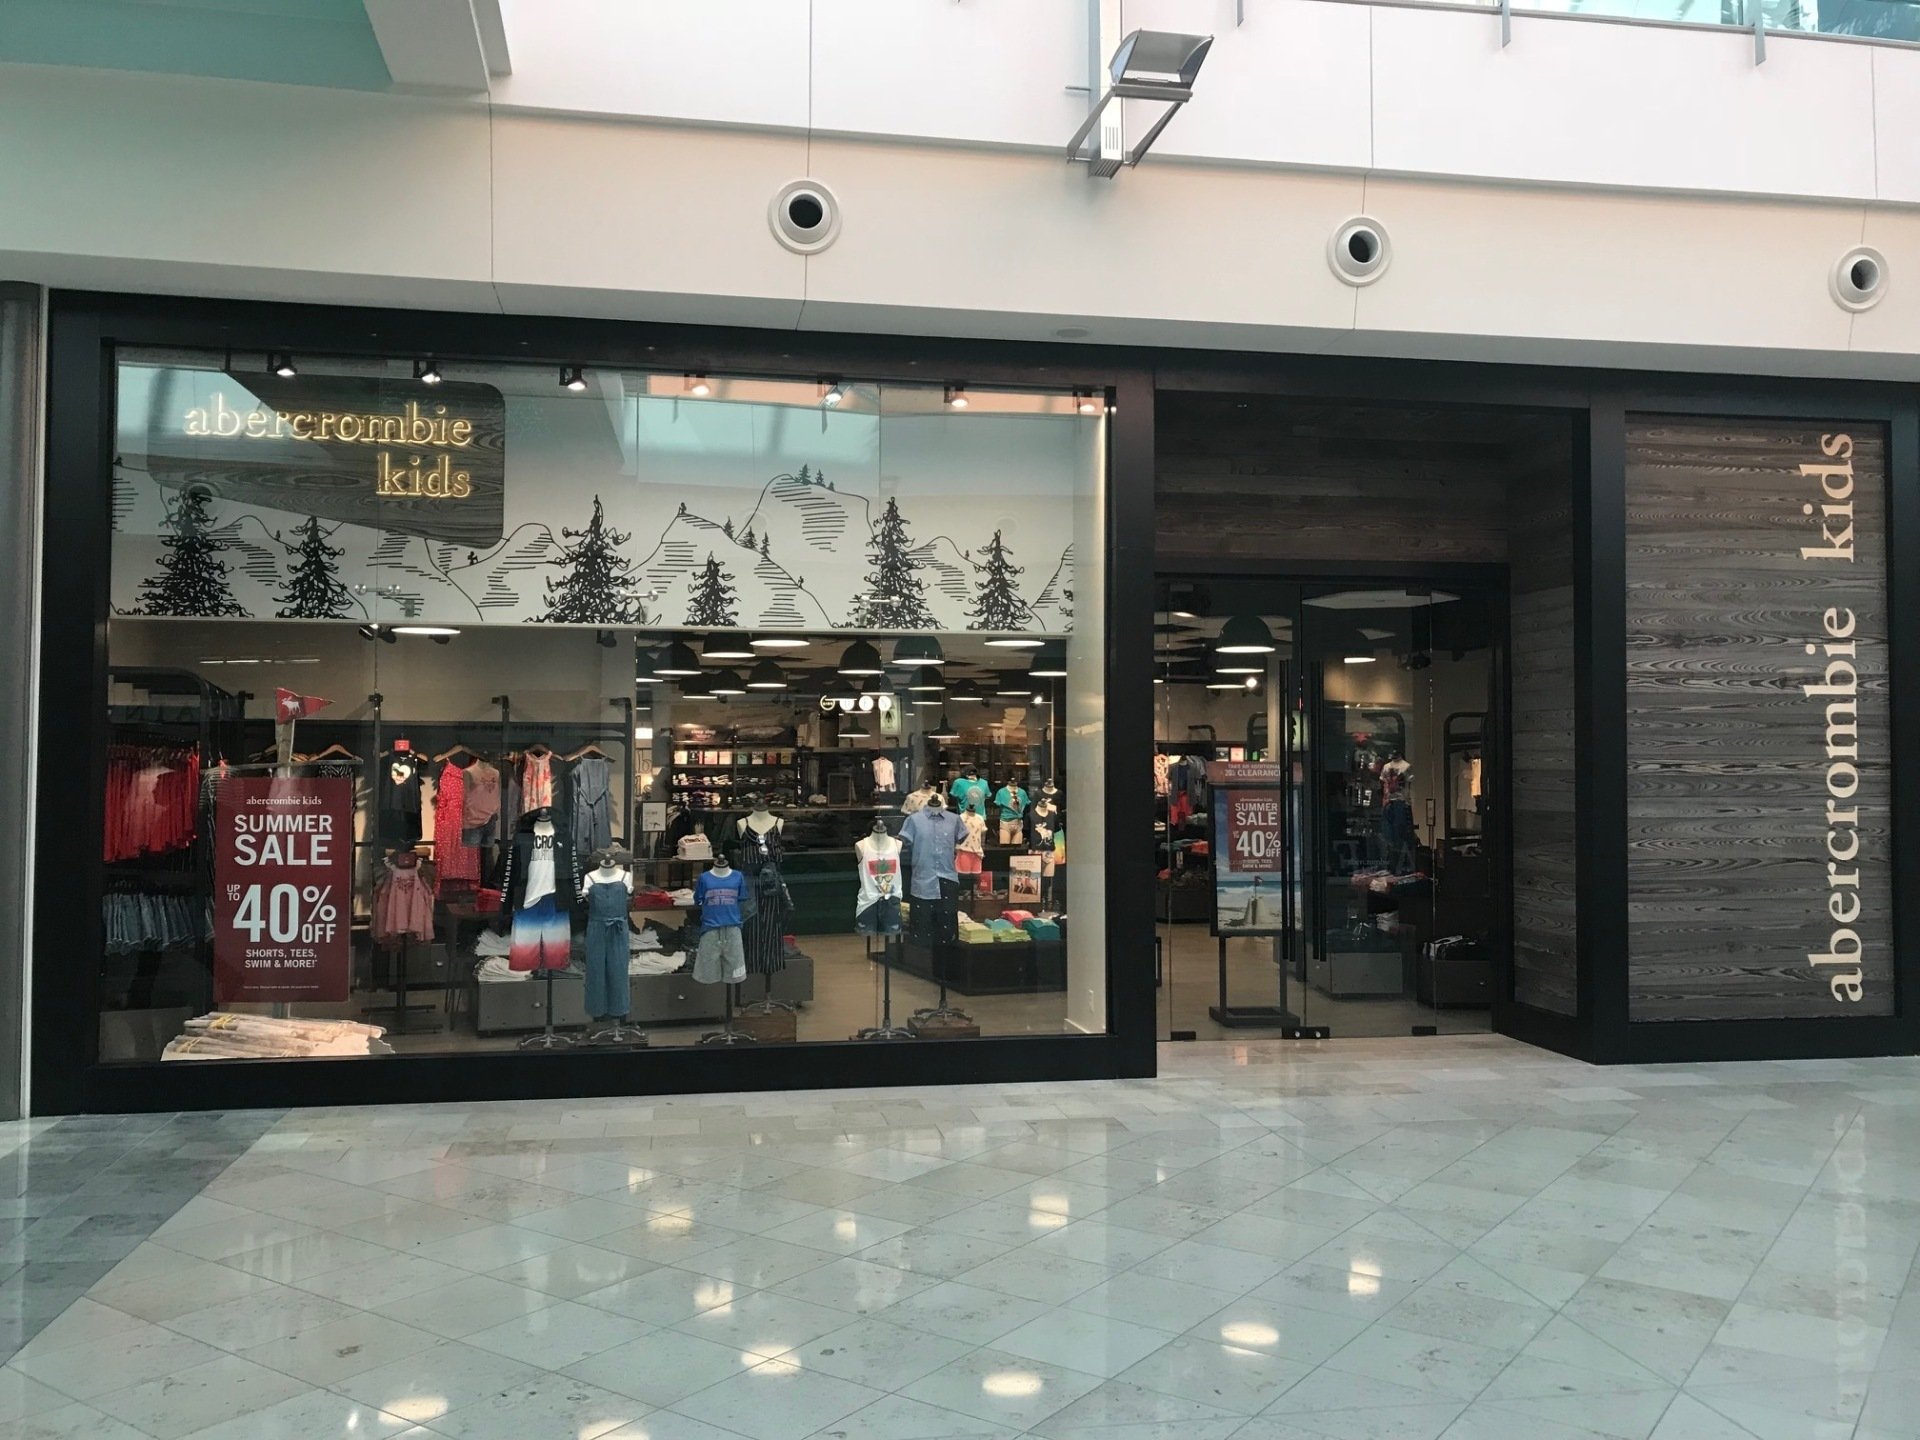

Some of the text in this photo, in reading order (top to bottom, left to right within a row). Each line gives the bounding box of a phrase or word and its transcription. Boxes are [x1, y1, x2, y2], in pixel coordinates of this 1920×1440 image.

[183, 392, 472, 446] abercrombie
[376, 452, 471, 498] kids
[1799, 432, 1864, 1003] abercrombie kids
[246, 795, 322, 805] abercrombie kids
[1234, 802, 1278, 812] SUMMER
[234, 814, 333, 833] SUMMER
[1236, 811, 1278, 826] SALE
[233, 834, 333, 866] SALE
[1236, 830, 1281, 857] 40%
[1265, 848, 1281, 857] OFF
[226, 884, 241, 893] UP
[227, 892, 240, 901] TO
[232, 883, 337, 943] 40%
[301, 923, 336, 944] OFF
[245, 949, 318, 959] SHORTS, TEES,
[244, 959, 272, 968] SWIM
[274, 959, 282, 968] &
